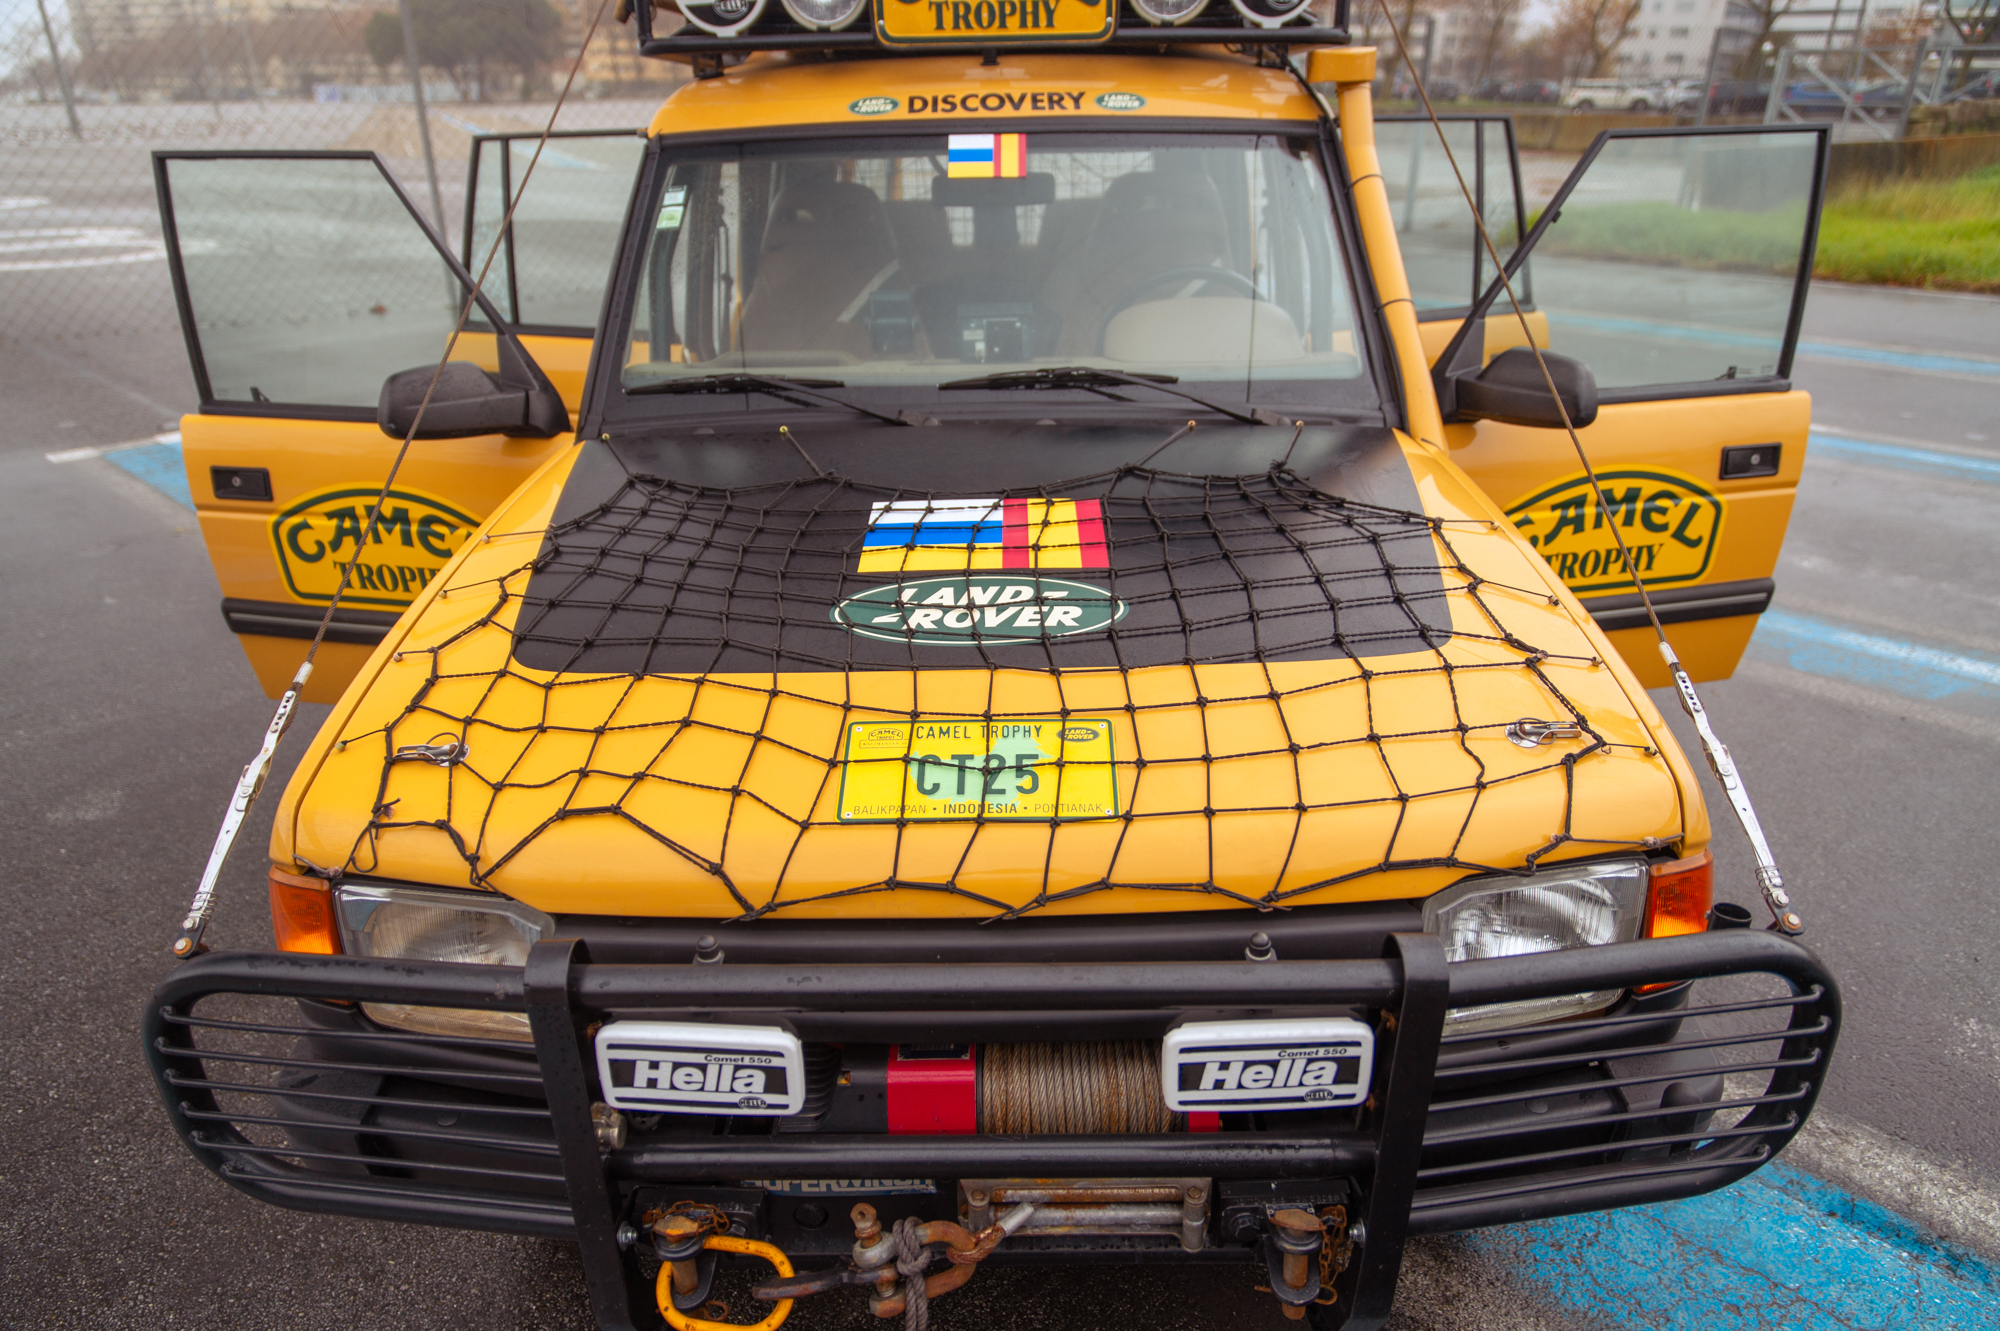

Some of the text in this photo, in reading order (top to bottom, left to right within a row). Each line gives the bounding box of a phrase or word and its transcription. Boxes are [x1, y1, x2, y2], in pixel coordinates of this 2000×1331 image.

[929, 0, 1060, 30] TROPHY
[908, 91, 1086, 114] DISCOVERY
[286, 504, 473, 563] CAME
[333, 560, 442, 593] TROPH
[870, 730, 902, 738] CAMEL
[916, 725, 1042, 739] CAMEL TROPHY
[916, 754, 1039, 795] CT25
[853, 803, 1103, 815] BALIKPAPAN INDONESIA PONTIANAK
[704, 1055, 772, 1065] Comet 550
[1278, 1048, 1347, 1058] Comet 550
[633, 1060, 766, 1094] Hella
[1199, 1058, 1338, 1091] Hella
